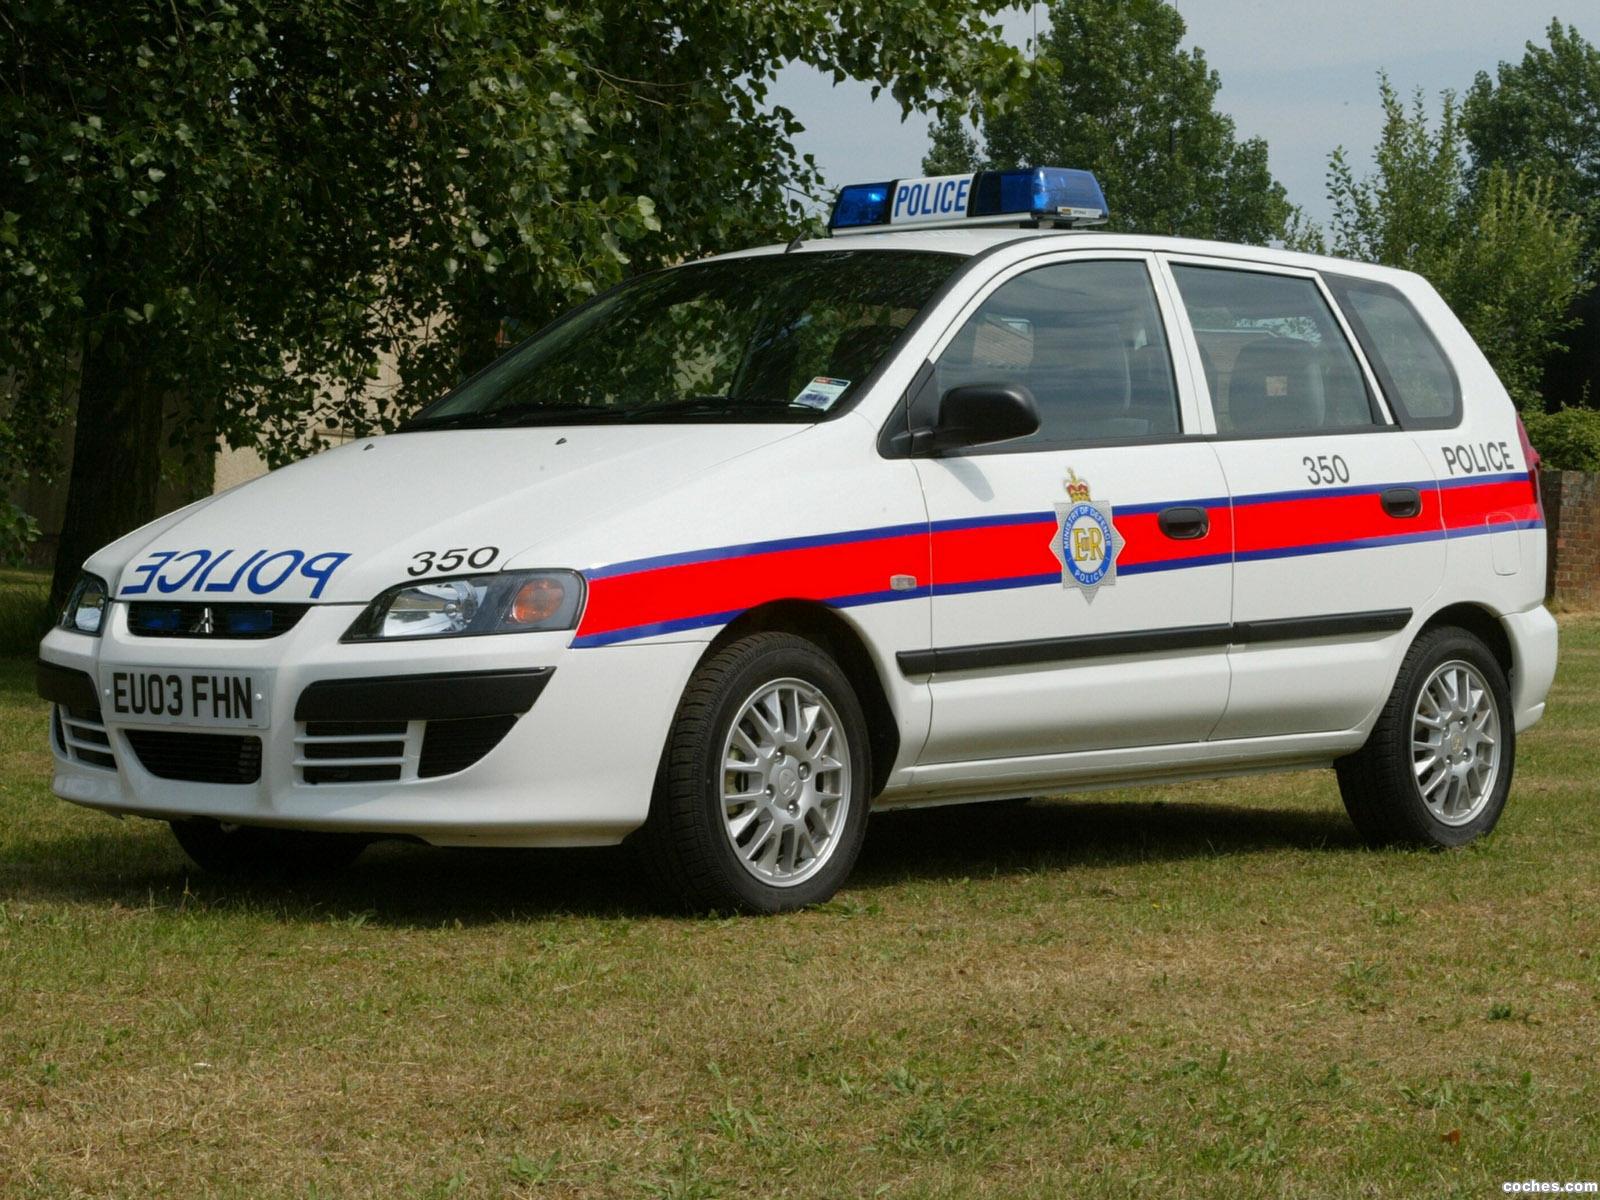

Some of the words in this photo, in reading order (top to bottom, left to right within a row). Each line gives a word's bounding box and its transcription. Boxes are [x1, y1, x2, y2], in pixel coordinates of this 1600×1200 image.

[894, 179, 970, 217] POLICE
[1303, 454, 1350, 485] 350
[1441, 441, 1515, 475] POLICE
[1063, 509, 1079, 549] MINISTRY
[1080, 505, 1089, 516] OF
[407, 546, 500, 577] 350
[1074, 567, 1104, 584] POLICE
[113, 672, 183, 717] EU03
[191, 676, 253, 720] FHN
